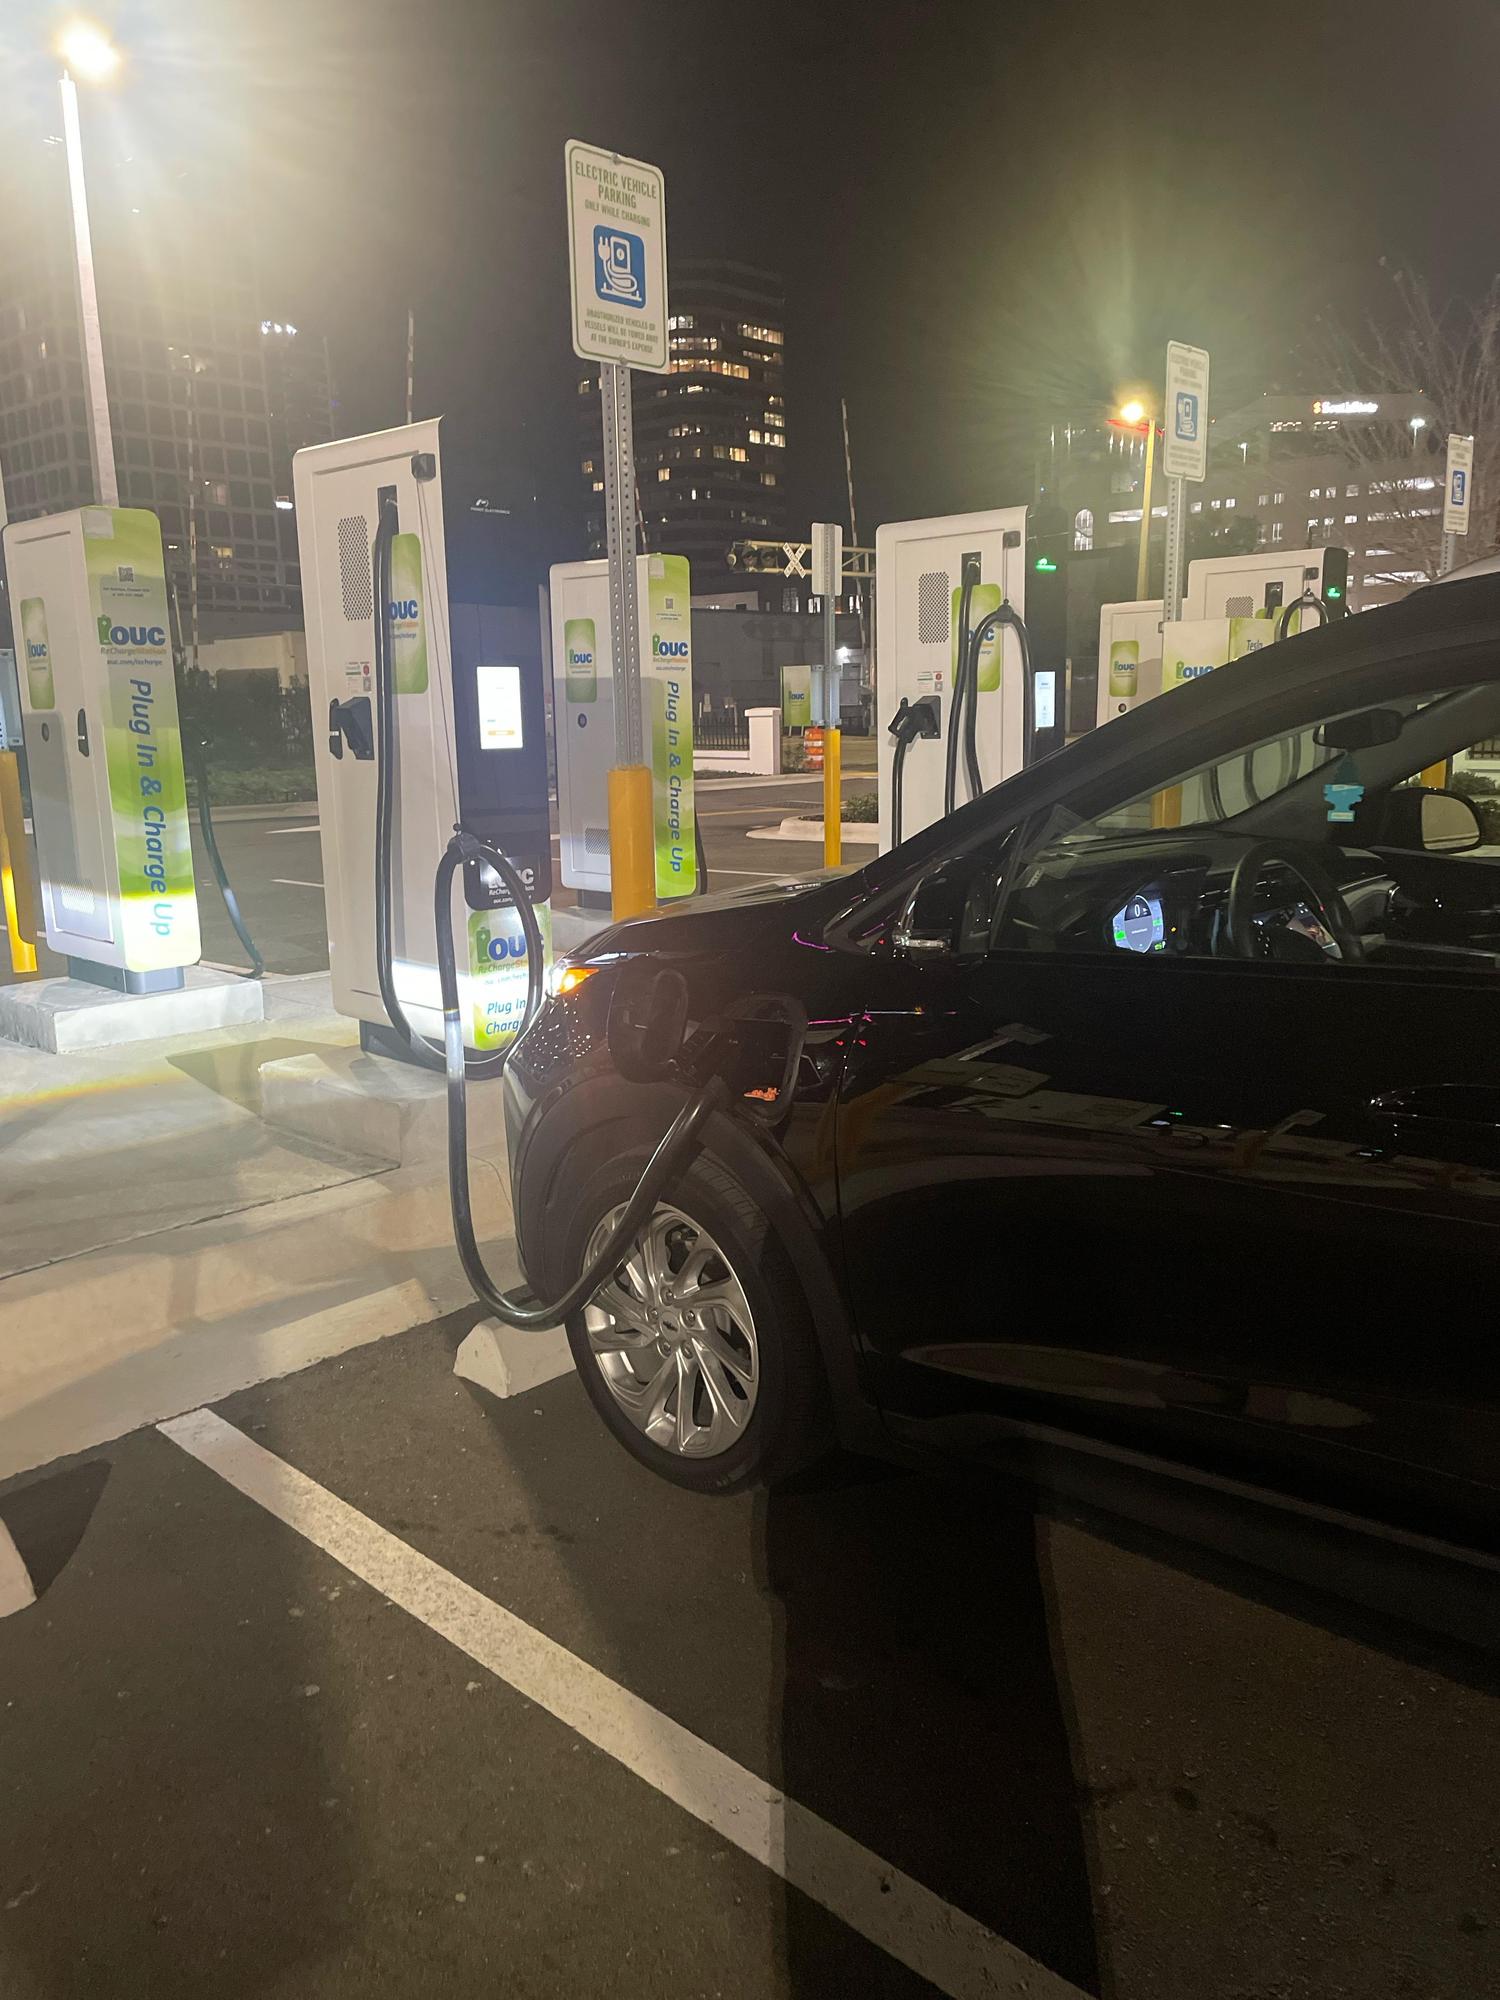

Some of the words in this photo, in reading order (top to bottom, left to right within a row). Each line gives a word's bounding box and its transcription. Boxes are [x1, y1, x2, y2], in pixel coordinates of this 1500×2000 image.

[575, 160, 618, 187] ELECTRIC
[621, 175, 657, 199] VEHICLE
[598, 184, 637, 209] PARKING
[584, 199, 600, 212] ONLY
[601, 204, 620, 219] WHILE
[621, 210, 651, 228] CHARGING
[388, 600, 418, 620] OUC
[110, 626, 166, 646] OUC
[573, 653, 593, 664] OUC
[659, 641, 689, 656] OUC
[129, 678, 154, 736] Plug
[665, 680, 680, 723] Plug
[668, 728, 680, 746] In
[136, 743, 158, 767] In
[669, 752, 681, 768] &
[139, 775, 162, 797] &
[667, 775, 682, 840] Charge
[142, 805, 167, 895] Charge
[669, 846, 684, 872] Up
[149, 902, 174, 936] Up
[1134, 904, 1141, 917] 0
[487, 1001, 512, 1015] Plug
[515, 998, 526, 1010] In
[485, 1020, 523, 1035] Charg
